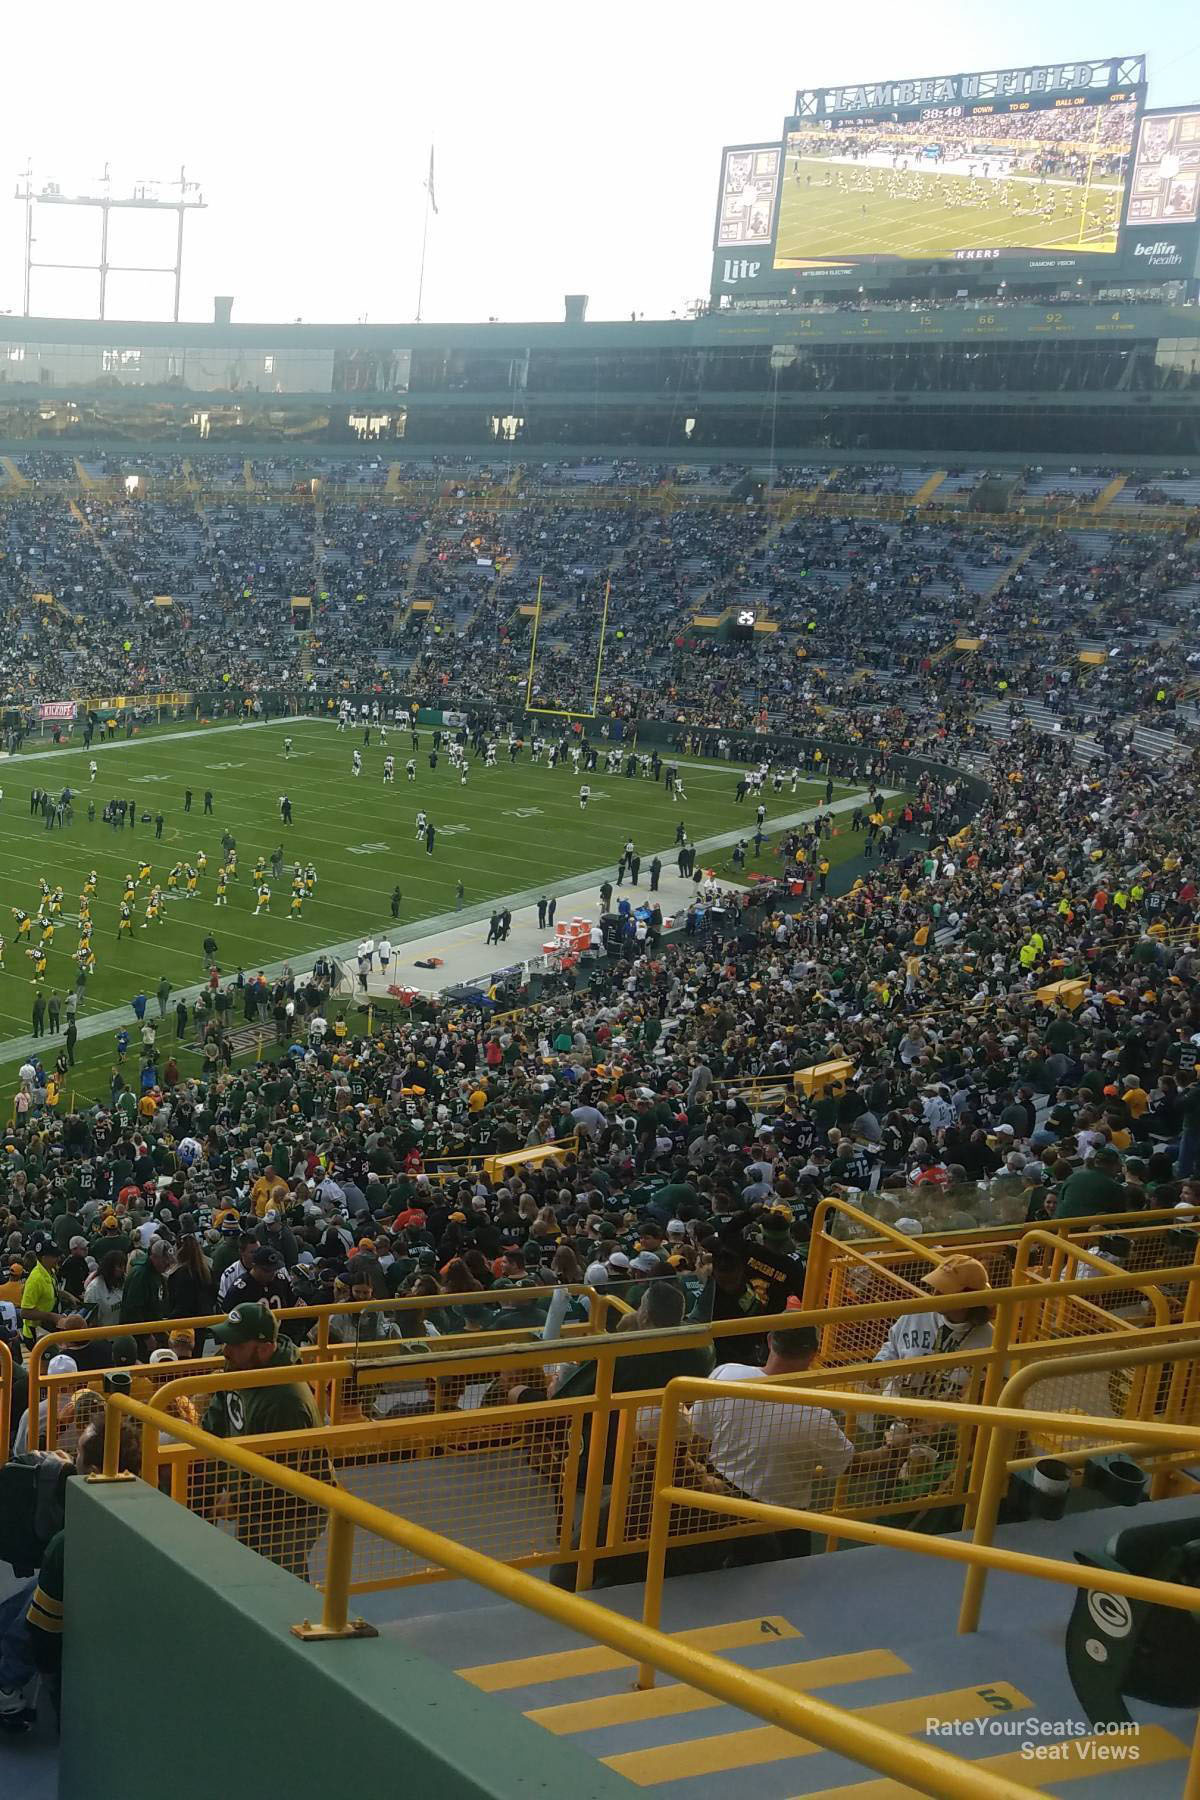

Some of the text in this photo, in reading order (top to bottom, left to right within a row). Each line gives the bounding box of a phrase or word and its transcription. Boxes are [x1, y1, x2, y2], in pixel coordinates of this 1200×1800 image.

[833, 65, 1093, 111] LAMBEAU FIELD
[1055, 99, 1073, 107] BALL
[972, 106, 993, 114] DOWN
[1134, 242, 1176, 256] bellin
[1148, 254, 1183, 266] health
[721, 259, 761, 284] Lite
[919, 316, 932, 325] 15
[978, 315, 995, 325] 66
[1045, 313, 1062, 323] 92
[479, 1131, 491, 1145] 17
[796, 1132, 813, 1150] 94
[183, 1145, 196, 1155] 34
[975, 1688, 1014, 1711] 5
